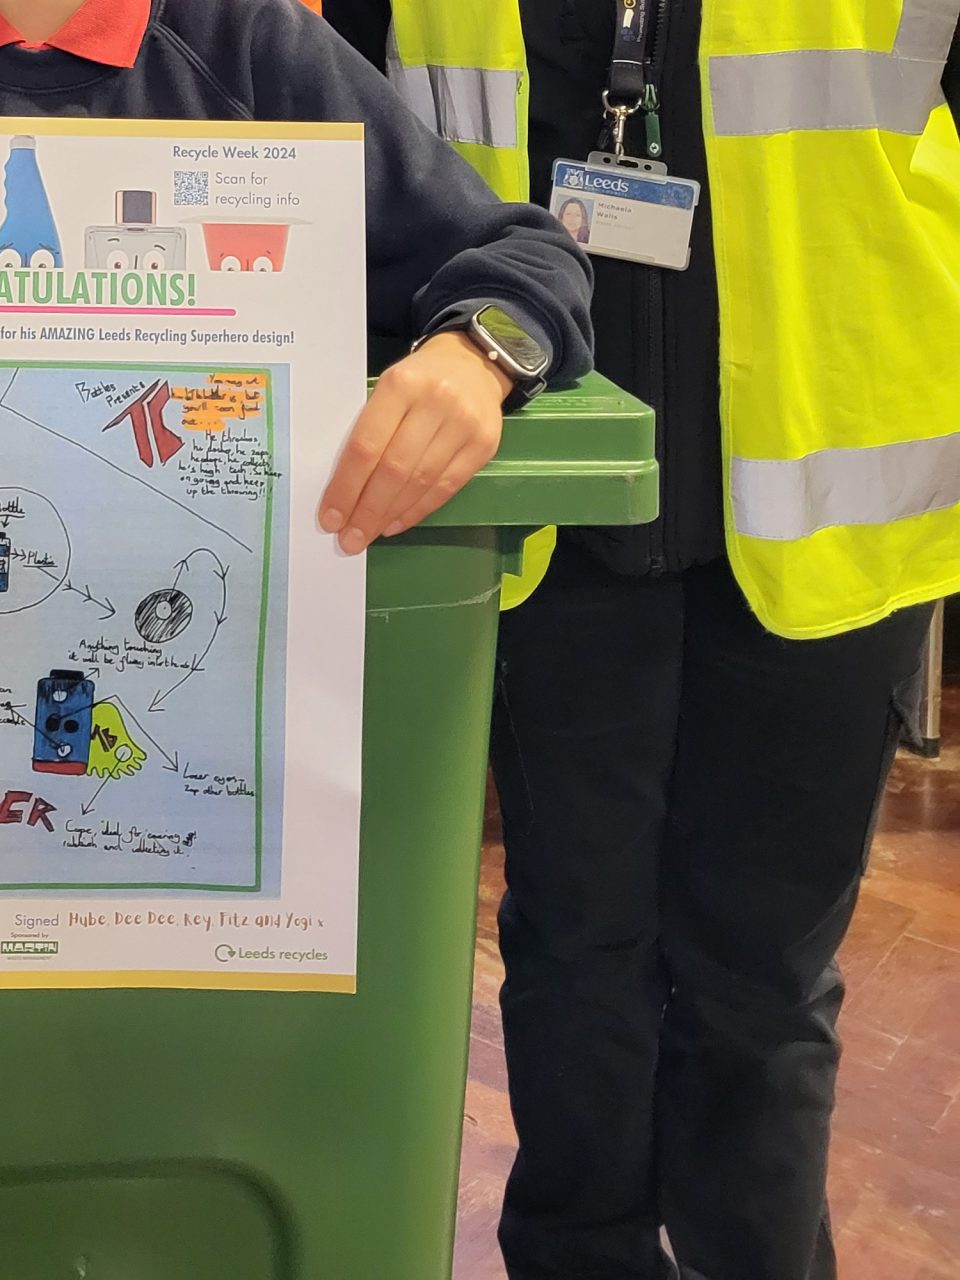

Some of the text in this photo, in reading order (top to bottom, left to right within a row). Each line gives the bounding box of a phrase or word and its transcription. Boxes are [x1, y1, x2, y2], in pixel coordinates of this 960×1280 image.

[173, 145, 297, 160] Recycle Week 2024
[215, 172, 268, 185] Scan for
[585, 174, 630, 193] Leeds
[215, 192, 300, 209] recycling info
[0, 326, 16, 340] for
[20, 326, 37, 341] his
[40, 328, 95, 340] AMAZING
[99, 328, 132, 341] Leeds
[135, 329, 188, 345] Recycling
[190, 330, 249, 346] Superhero
[252, 330, 295, 347] design!
[15, 913, 59, 930] Signed
[114, 912, 141, 925] Dee
[255, 915, 280, 928] and
[286, 912, 312, 930] Yogi
[238, 946, 329, 962] Leeds recycles
